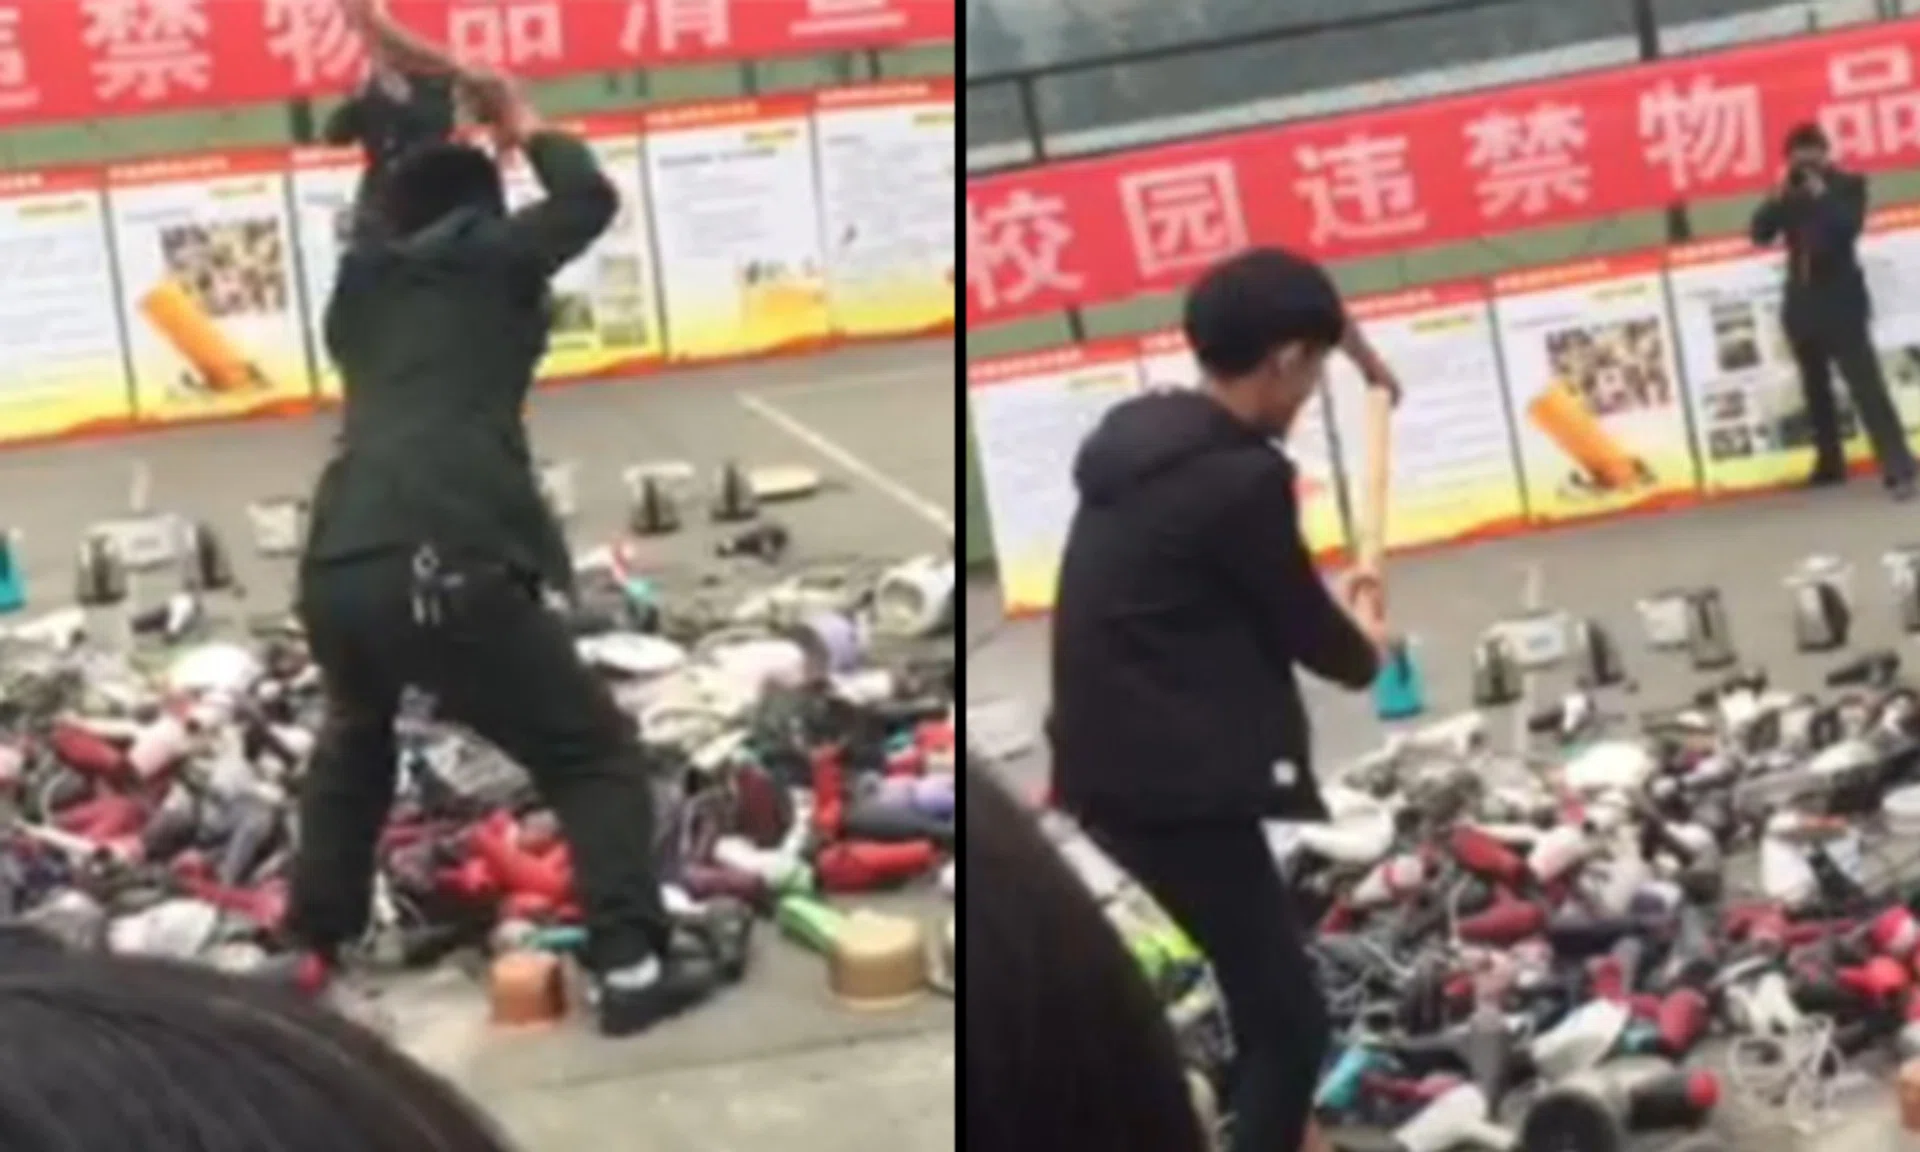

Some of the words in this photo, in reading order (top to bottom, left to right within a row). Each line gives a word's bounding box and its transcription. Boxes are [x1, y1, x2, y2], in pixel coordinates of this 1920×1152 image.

[966, 43, 1920, 309] 校园违禁物品
